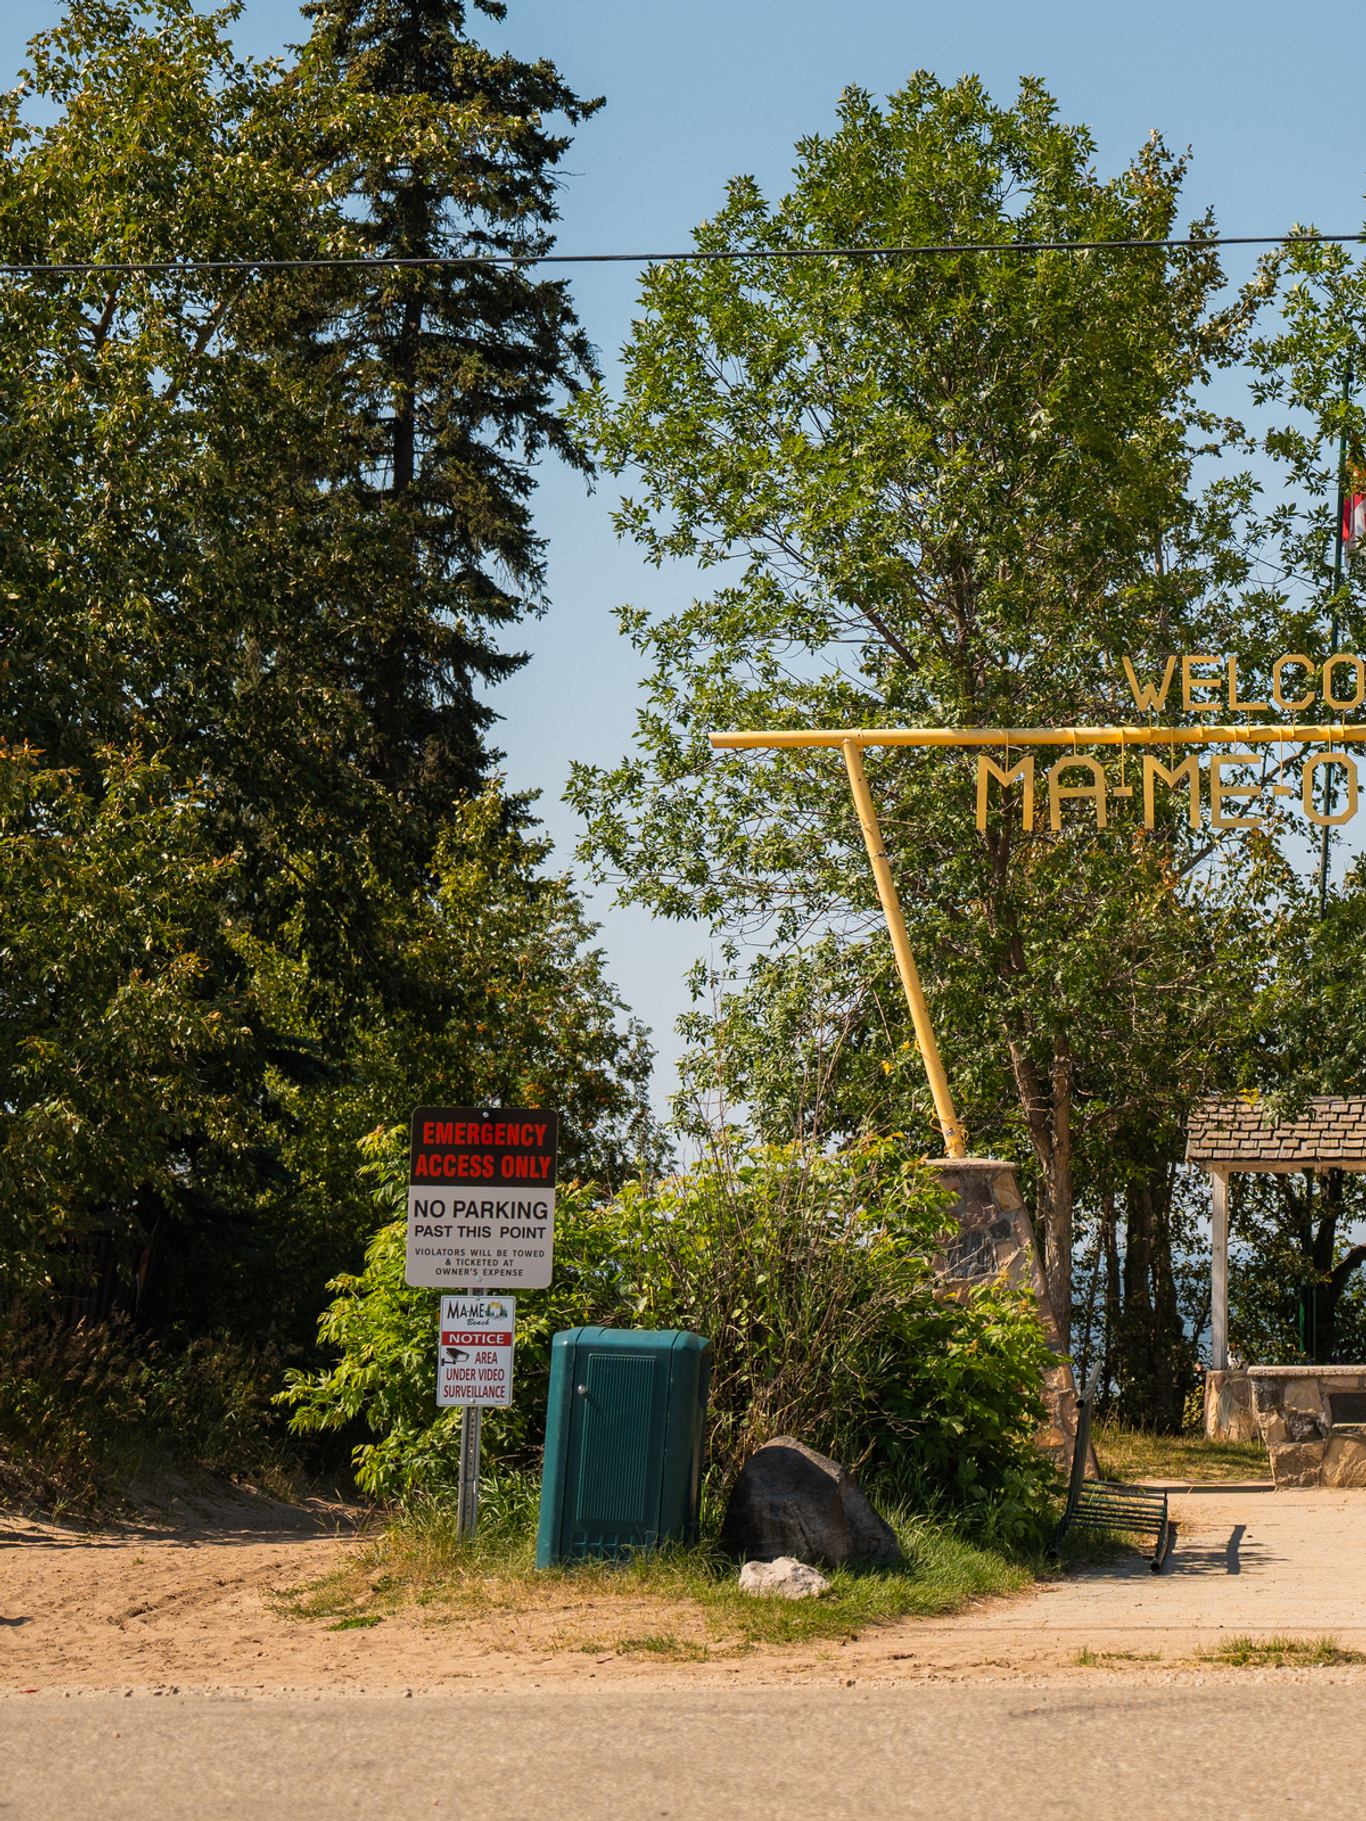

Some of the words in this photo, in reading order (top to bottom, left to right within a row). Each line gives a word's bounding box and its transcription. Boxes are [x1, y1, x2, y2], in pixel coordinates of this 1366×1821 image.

[976, 752, 1359, 831] MA-ME-O
[423, 1121, 547, 1147] EMERGENCY
[415, 1153, 495, 1178] ACCESS
[501, 1155, 551, 1179] ONLY
[414, 1199, 446, 1218] NO
[453, 1200, 548, 1220] PARKING
[414, 1225, 453, 1238] PAST
[457, 1225, 492, 1239] THIS
[500, 1226, 546, 1239] POINT
[414, 1248, 466, 1257] VIOLATORS
[470, 1249, 492, 1257] WILL
[496, 1249, 508, 1257] BE
[512, 1249, 545, 1258] TOWED
[456, 1258, 499, 1267] TICKETED
[503, 1259, 514, 1267] AT
[435, 1267, 478, 1276] OWNER'S
[482, 1268, 523, 1277] EXPENSE
[449, 1333, 505, 1345] NOTICE
[474, 1351, 498, 1364] AREA
[446, 1368, 476, 1381] UNDER
[478, 1368, 505, 1381] VIDEO
[443, 1385, 505, 1398] SURVEILLANCE
